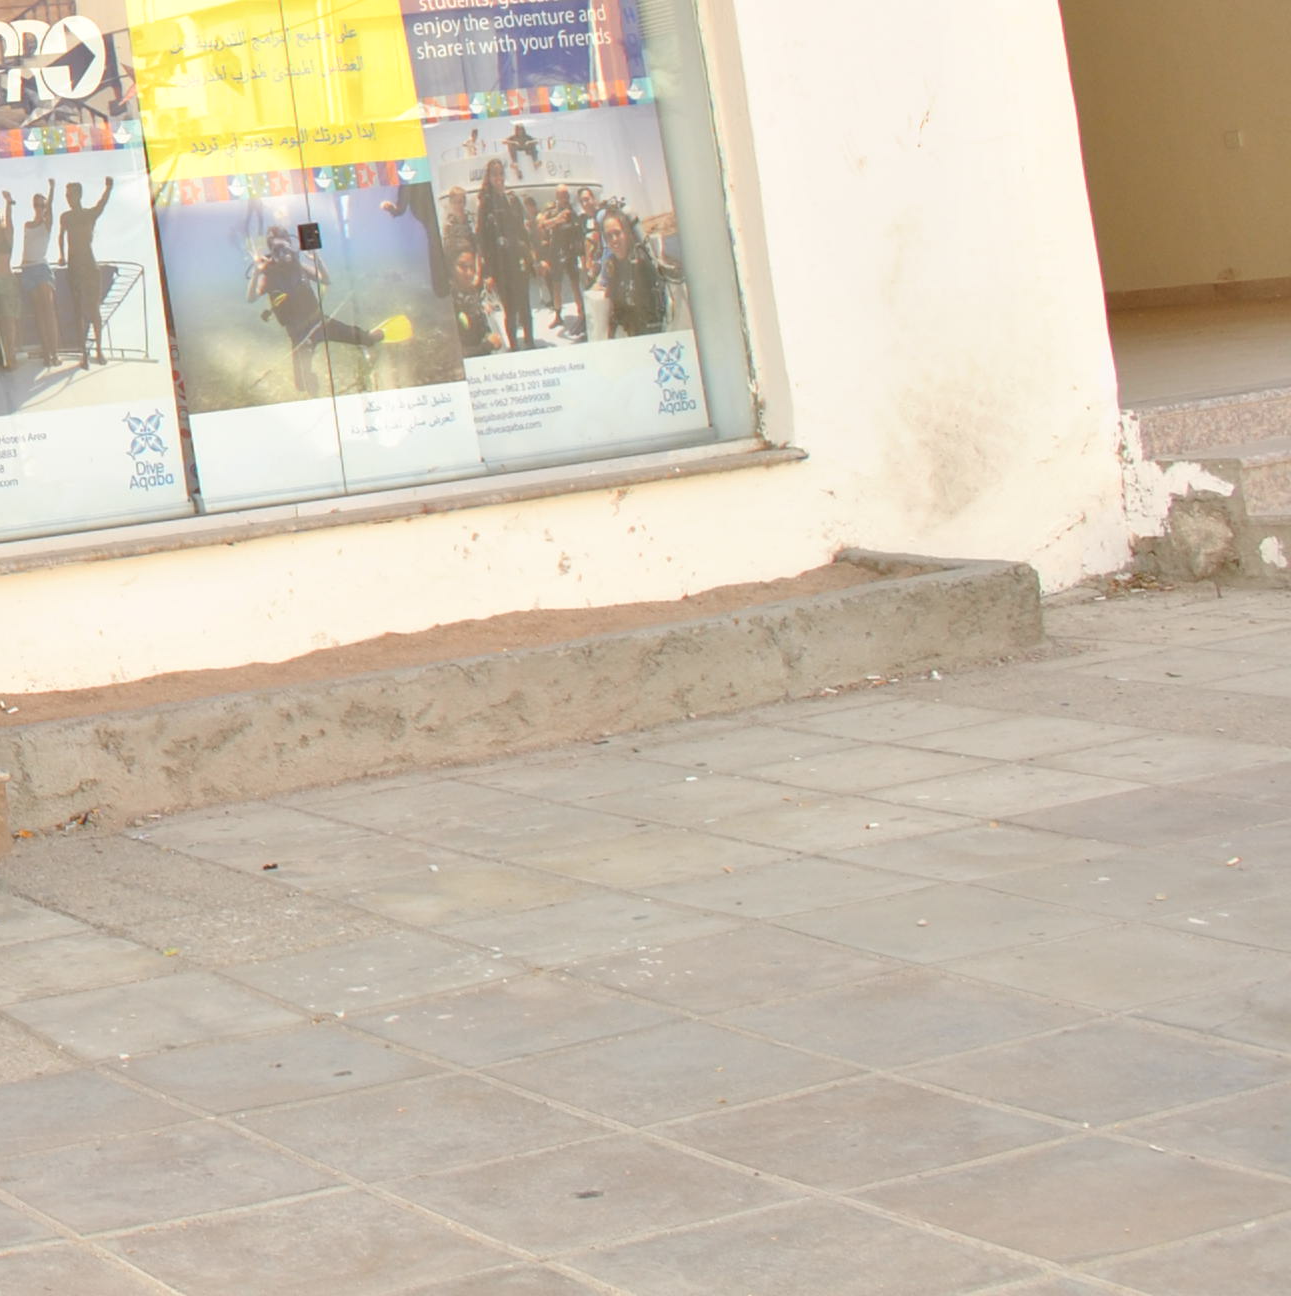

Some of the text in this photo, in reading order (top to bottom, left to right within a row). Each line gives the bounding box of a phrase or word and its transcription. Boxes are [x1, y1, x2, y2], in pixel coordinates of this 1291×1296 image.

[413, 5, 607, 42] enjoy the adventure and
[416, 28, 611, 61] share it with your firends
[518, 367, 542, 378] Street,
[568, 362, 585, 372] Area
[662, 388, 687, 402] Dive
[658, 400, 697, 415] Aqaba
[27, 431, 47, 442] Area
[135, 460, 165, 476] Dive
[129, 473, 175, 492] Aqaba
